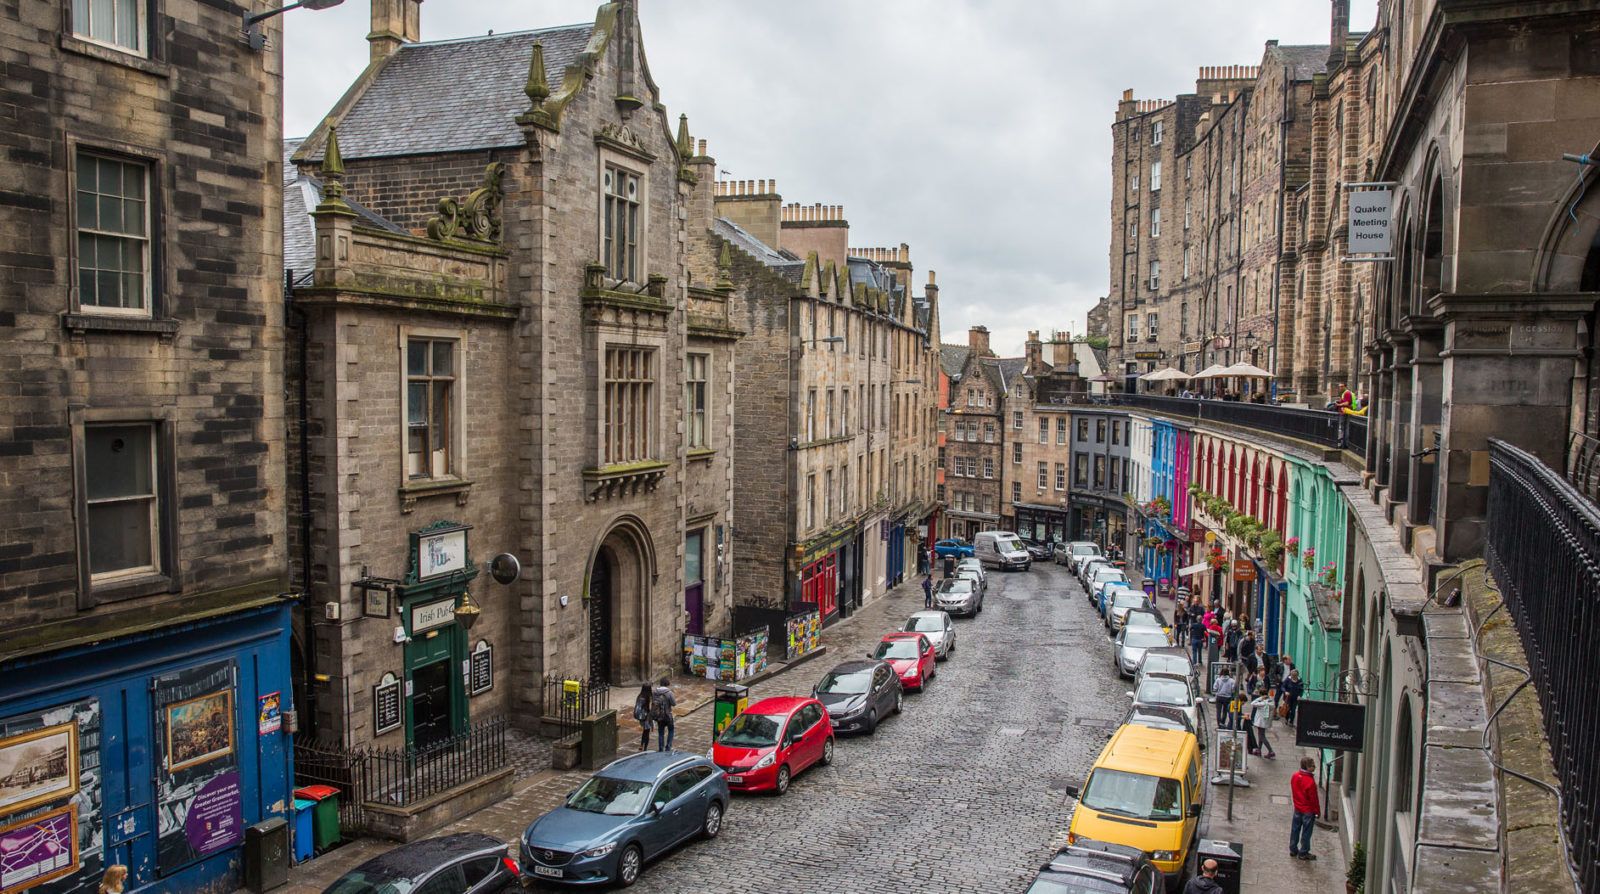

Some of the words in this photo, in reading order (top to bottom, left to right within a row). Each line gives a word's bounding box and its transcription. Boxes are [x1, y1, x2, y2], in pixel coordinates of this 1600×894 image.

[1354, 205, 1387, 214] Quaker
[1353, 219, 1388, 227] Meeting
[420, 609, 434, 623] Irish
[197, 790, 217, 801] Discover
[217, 786, 227, 794] your
[194, 799, 211, 809] Greater
